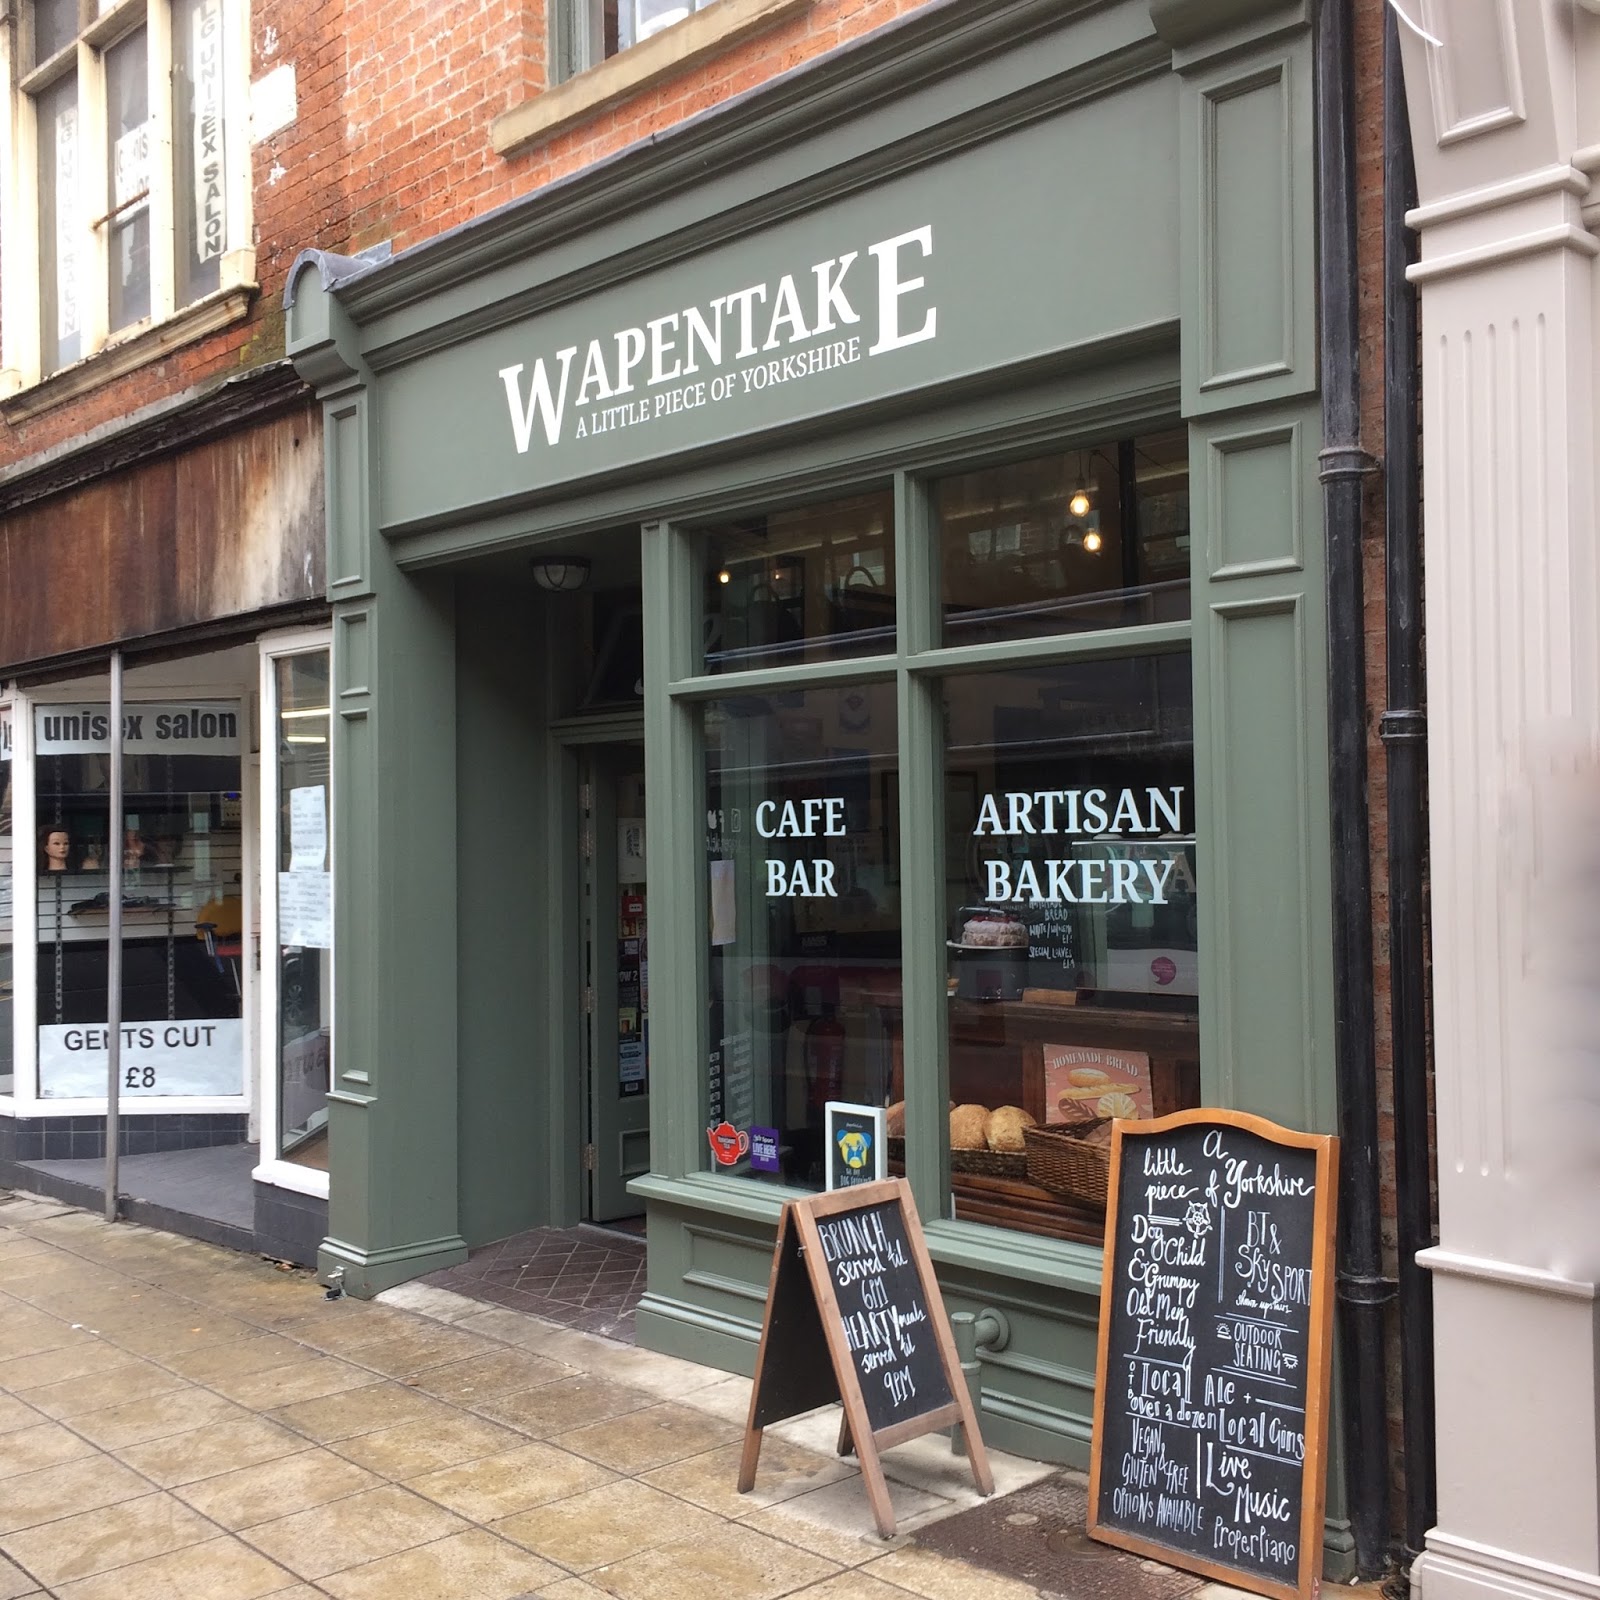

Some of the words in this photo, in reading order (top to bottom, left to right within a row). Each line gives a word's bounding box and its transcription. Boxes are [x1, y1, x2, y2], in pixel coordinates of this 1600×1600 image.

[202, 162, 221, 257] SALON
[499, 224, 937, 454] WAPENTAKE
[576, 416, 588, 439] A
[591, 399, 650, 436] LITTLE
[655, 382, 706, 418] PIECE
[711, 374, 736, 402] OF
[741, 336, 861, 394] YORKSHIRE
[156, 709, 237, 739] salon
[756, 797, 846, 838] CAFE
[973, 786, 1184, 836] ARTISAN
[765, 859, 838, 897] BAR
[984, 859, 1176, 905] BAKERY
[1045, 908, 1068, 921] BREAD
[164, 1026, 216, 1047] CUT
[125, 1066, 155, 1088] £8
[1052, 1052, 1102, 1070] HOMEMADE
[1106, 1055, 1139, 1077] BREAD
[1143, 1148, 1192, 1176] little
[1145, 1181, 1198, 1214] piece
[1205, 1169, 1220, 1207] of
[1224, 1159, 1315, 1208] Yorkshire
[818, 1211, 887, 1262] BRUNCH
[1164, 1237, 1206, 1266] Child
[1248, 1210, 1271, 1247] BT
[1269, 1223, 1282, 1255] &
[836, 1250, 886, 1286] served
[1128, 1248, 1150, 1281] &
[1144, 1263, 1200, 1308] Grumpy
[861, 1276, 889, 1310] 6PM
[1126, 1287, 1154, 1316] Old
[1156, 1293, 1187, 1321] Men
[841, 1305, 901, 1352] HEARTY
[1133, 1317, 1196, 1369] Friendly
[1234, 1322, 1282, 1350] OUTDOOR
[861, 1344, 897, 1374] served
[1233, 1342, 1281, 1375] SEATING
[883, 1365, 916, 1407] 9PM
[1130, 1396, 1160, 1417] over
[1177, 1398, 1216, 1430] dozen
[1122, 1452, 1158, 1489] GLUTEN
[1166, 1459, 1189, 1494] FREE
[1206, 1442, 1252, 1496] Live
[1156, 1493, 1204, 1536] AVAILABLE
[1234, 1483, 1291, 1523] Music
